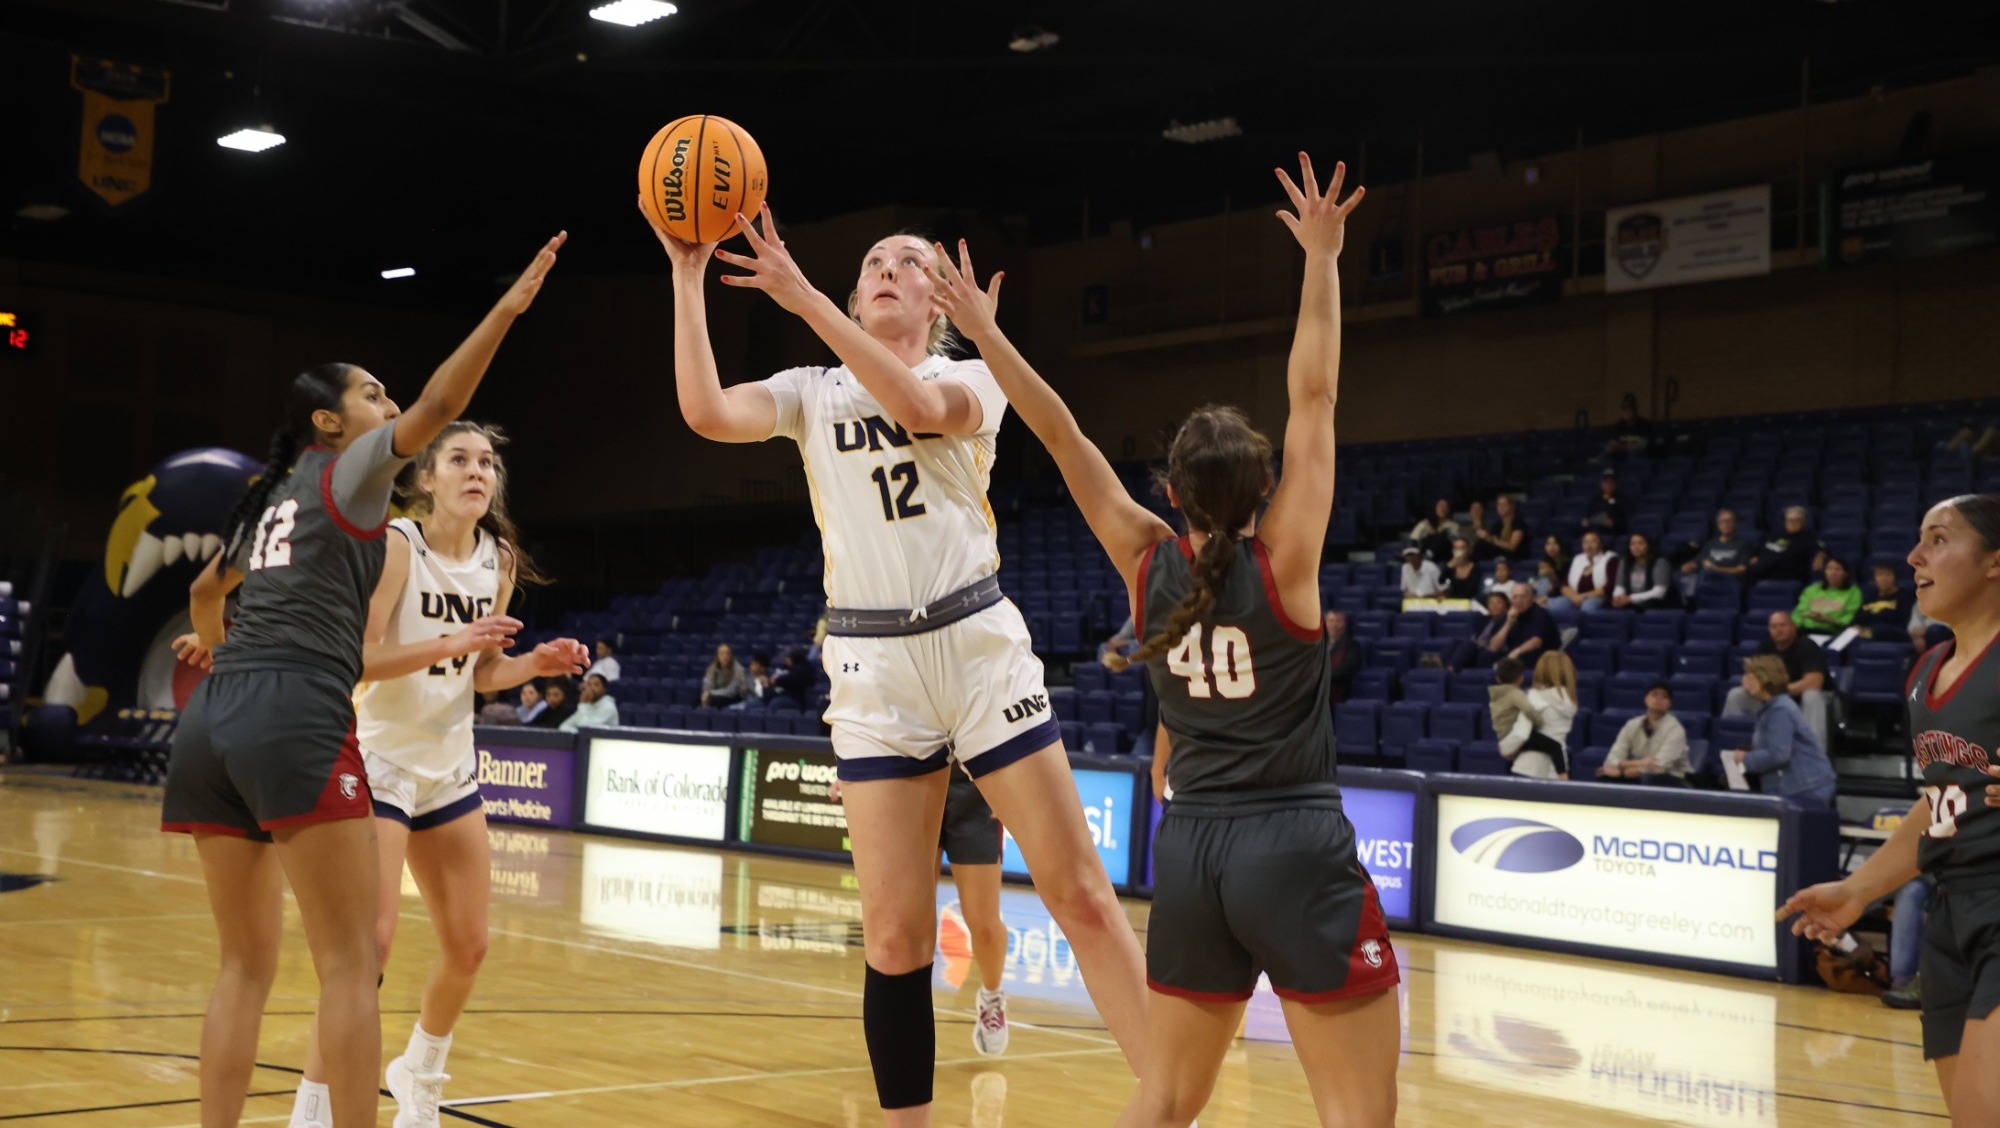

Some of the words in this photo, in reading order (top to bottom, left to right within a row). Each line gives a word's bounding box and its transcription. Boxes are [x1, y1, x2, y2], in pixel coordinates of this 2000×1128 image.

[662, 138, 691, 222] Wilson
[1428, 262, 1469, 289] PUB
[1493, 247, 1556, 279] GRILL
[10, 329, 29, 349] 12
[833, 414, 945, 453] UN
[871, 461, 927, 522] 12
[248, 497, 299, 572] 12
[1167, 622, 1256, 699] 40
[1002, 693, 1048, 723] UNC
[477, 749, 547, 789] Banner
[606, 768, 641, 794] Bank
[644, 771, 661, 796] of
[801, 764, 838, 785] woo
[508, 797, 552, 821] Medicine
[1593, 834, 1778, 874] McDONALD
[1594, 857, 1657, 879] TOYOTA
[1467, 891, 1756, 942] mcdonaldtoyotagreeley.com
